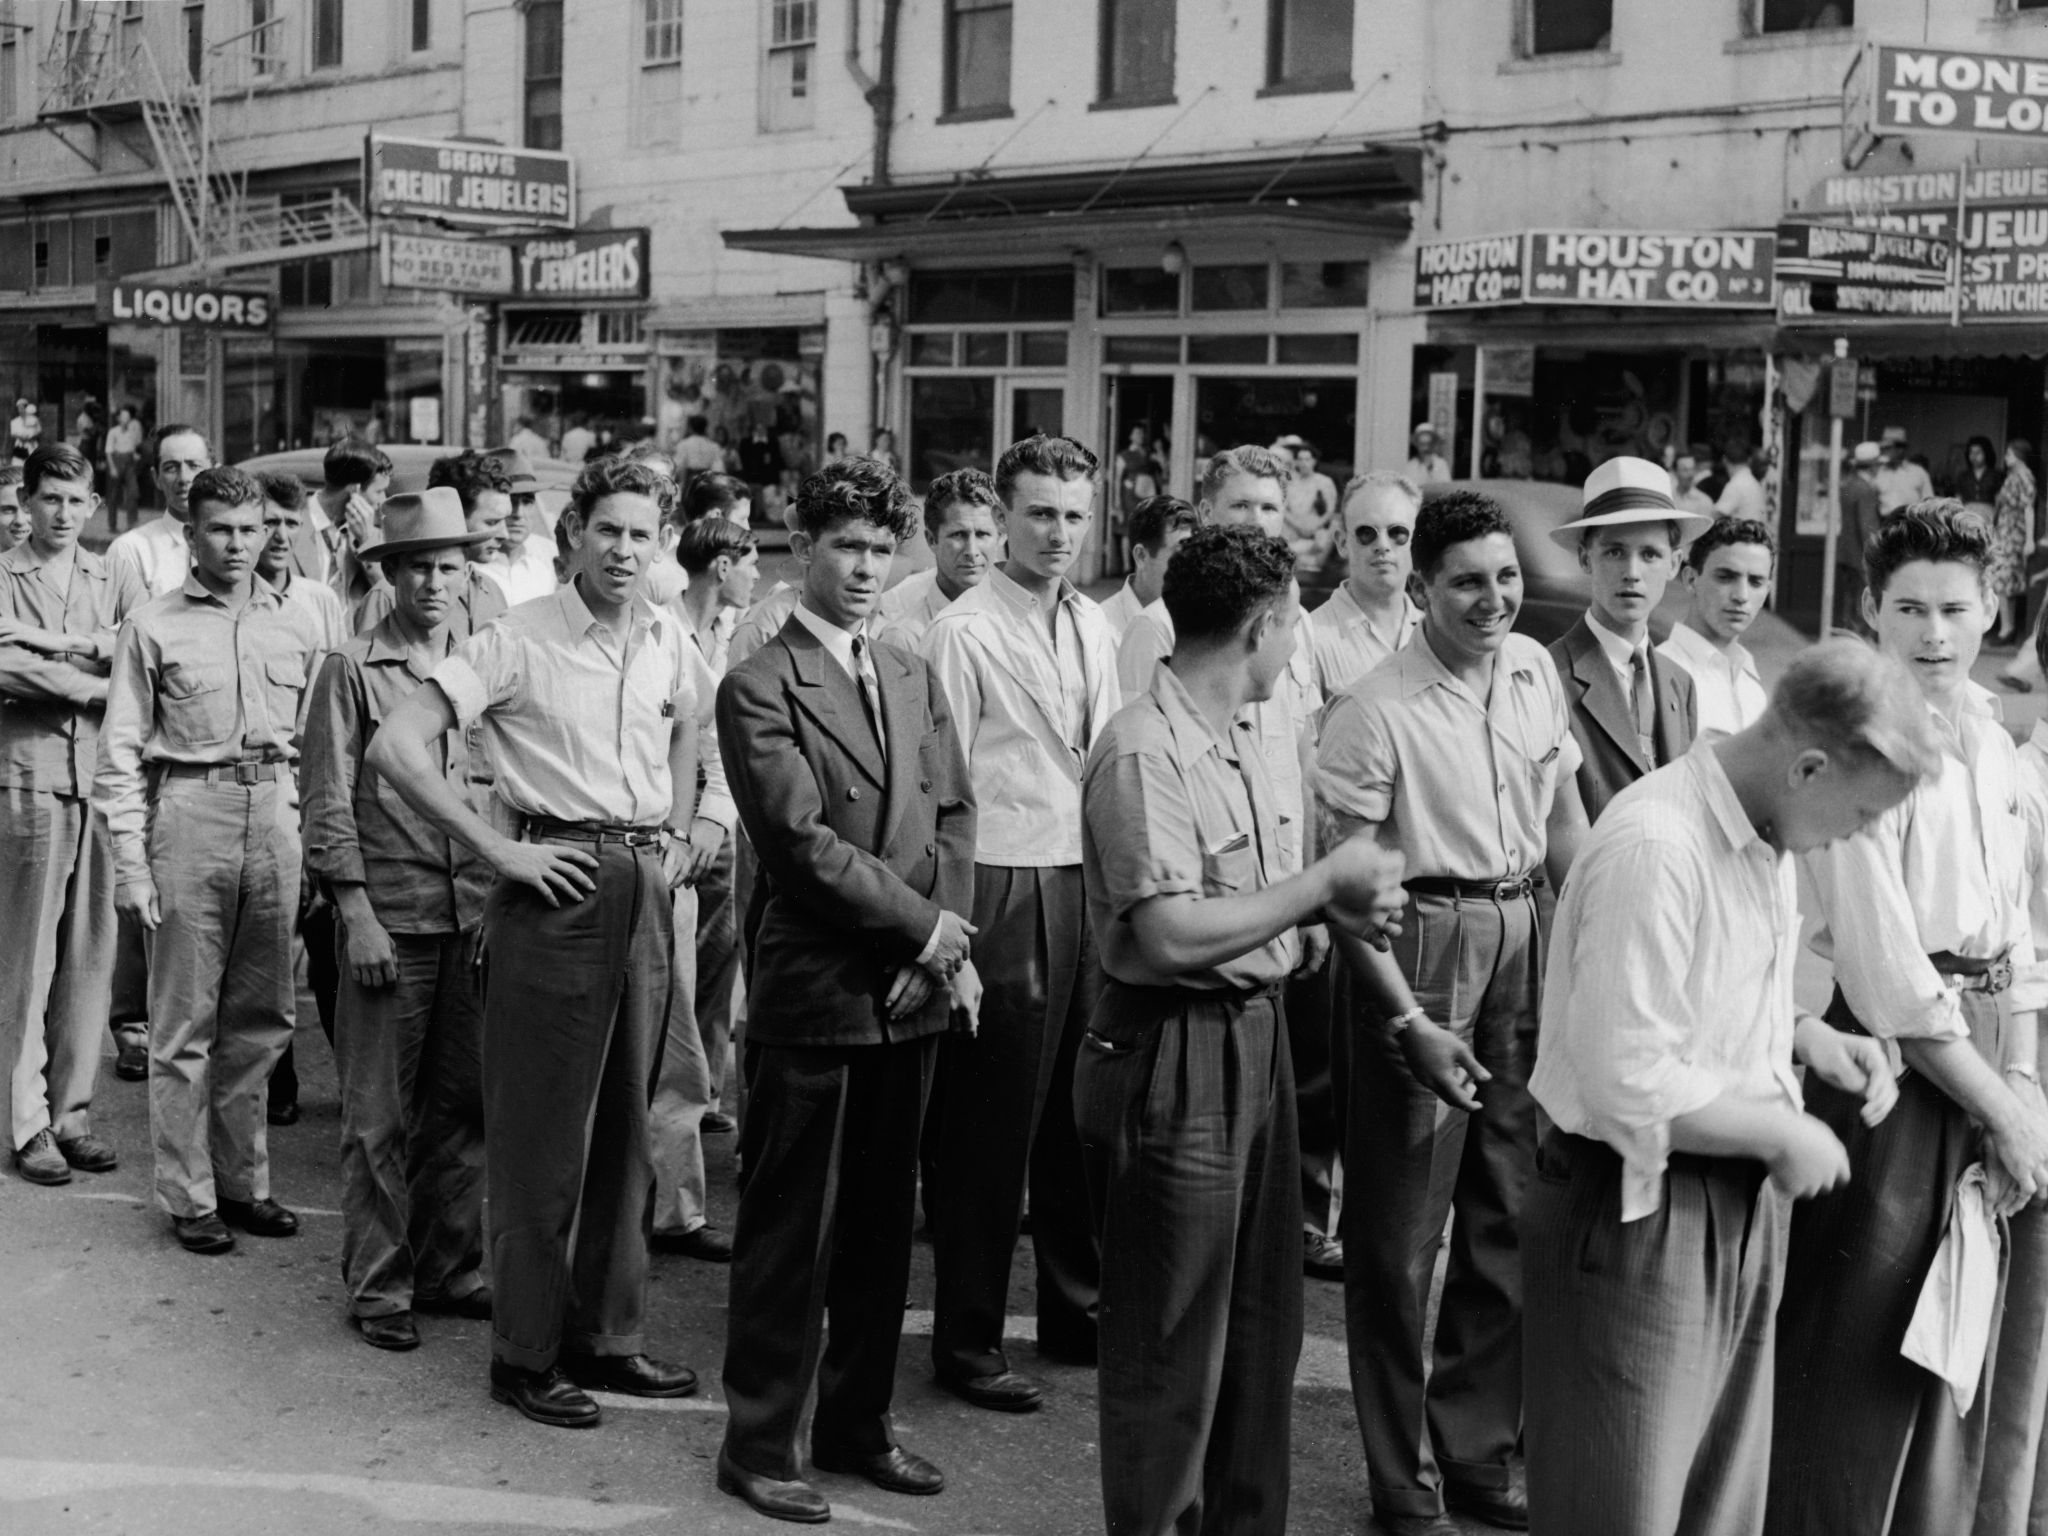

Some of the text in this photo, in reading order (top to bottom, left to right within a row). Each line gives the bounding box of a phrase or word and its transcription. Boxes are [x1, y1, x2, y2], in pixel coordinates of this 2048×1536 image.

[1894, 53, 2048, 96] MONE
[1885, 90, 2048, 132] TO LO
[382, 168, 568, 216] CREDIT JEWELERS
[1965, 168, 2048, 199] JEWE
[1963, 208, 2048, 249] JEW
[535, 238, 640, 290] JEWELERS
[1420, 236, 1520, 275] HOUSTON
[1546, 234, 1755, 269] HOUSTON
[460, 262, 502, 281] TAPE
[1432, 273, 1474, 305] HAT
[1577, 267, 1657, 300] HAT
[113, 286, 268, 326] LIQUORS
